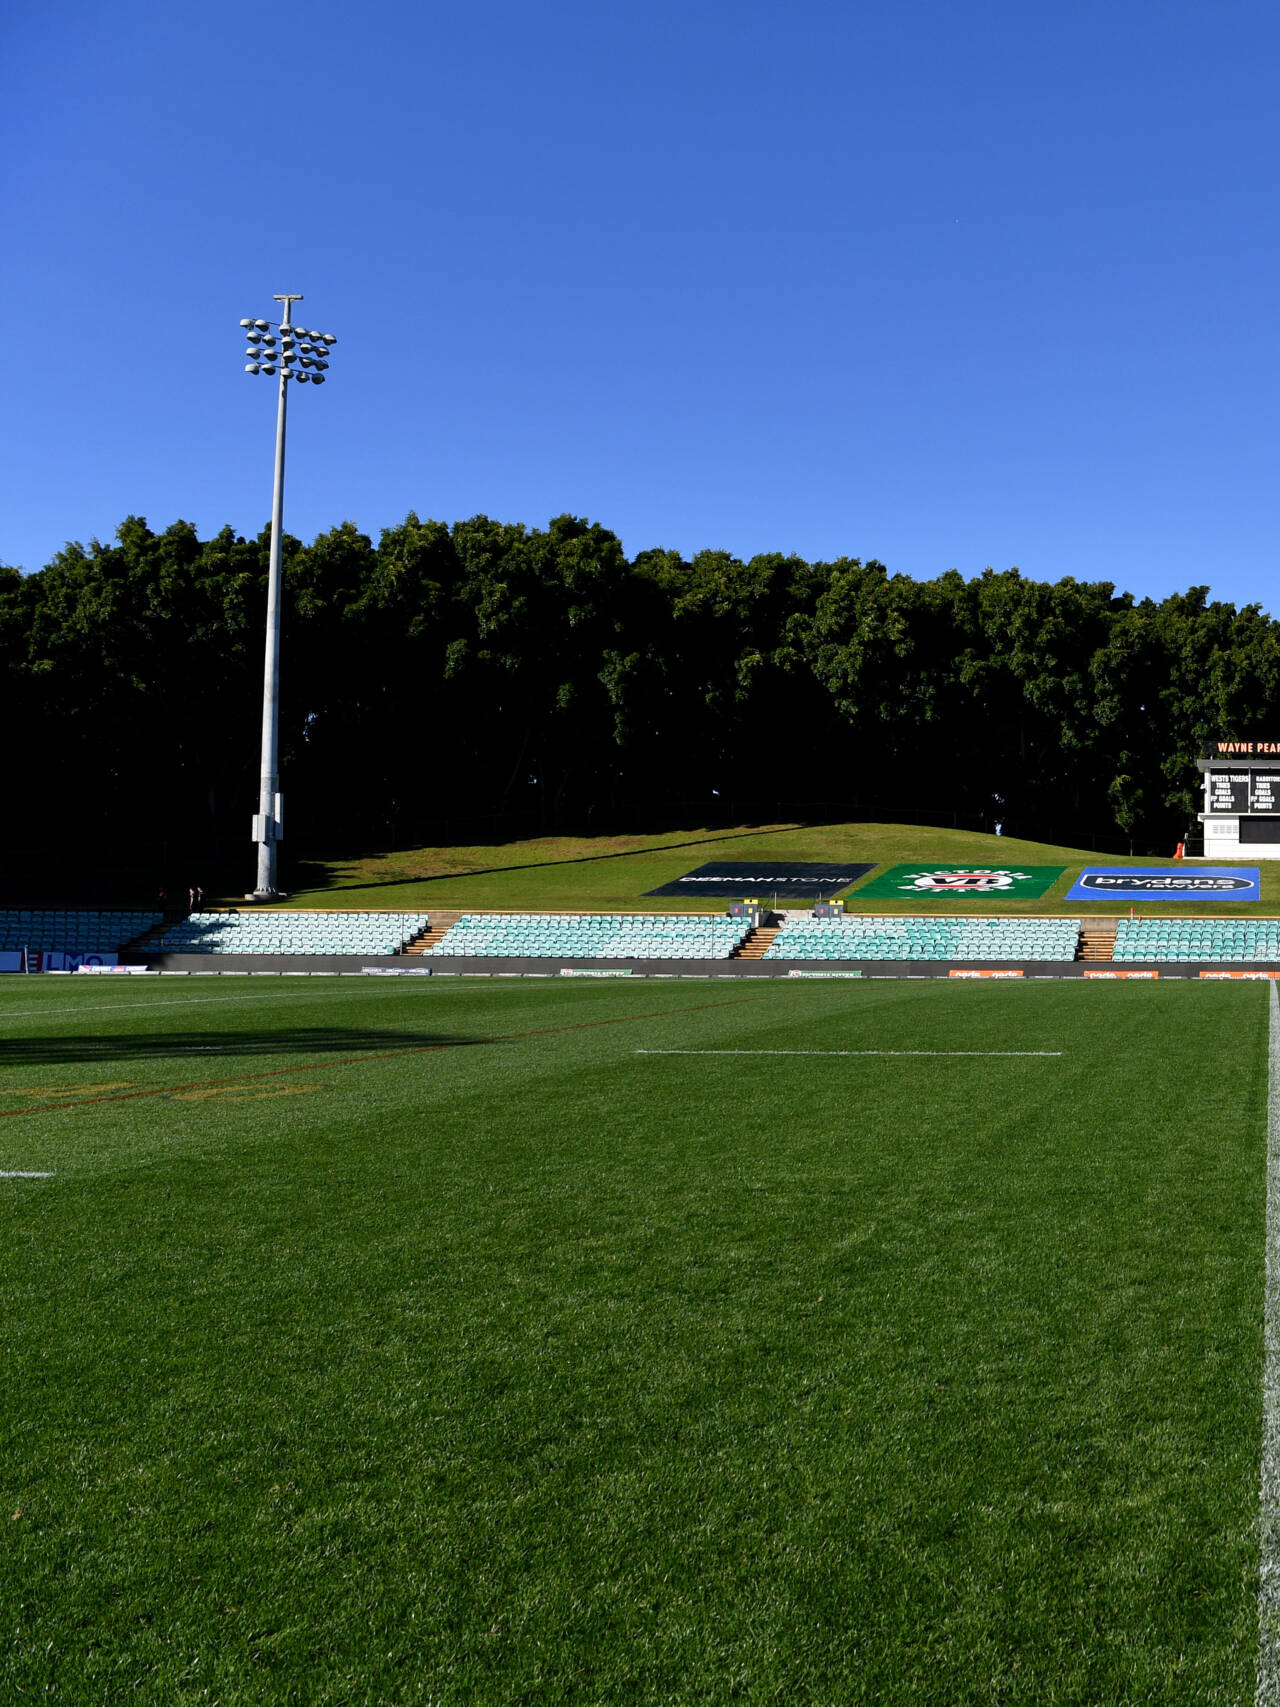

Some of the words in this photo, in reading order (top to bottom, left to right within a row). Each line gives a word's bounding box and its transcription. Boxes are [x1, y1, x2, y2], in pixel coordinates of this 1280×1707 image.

[1217, 742, 1254, 753] WAYNE
[1230, 775, 1249, 783] TIGERS
[1095, 877, 1236, 886] brydens
